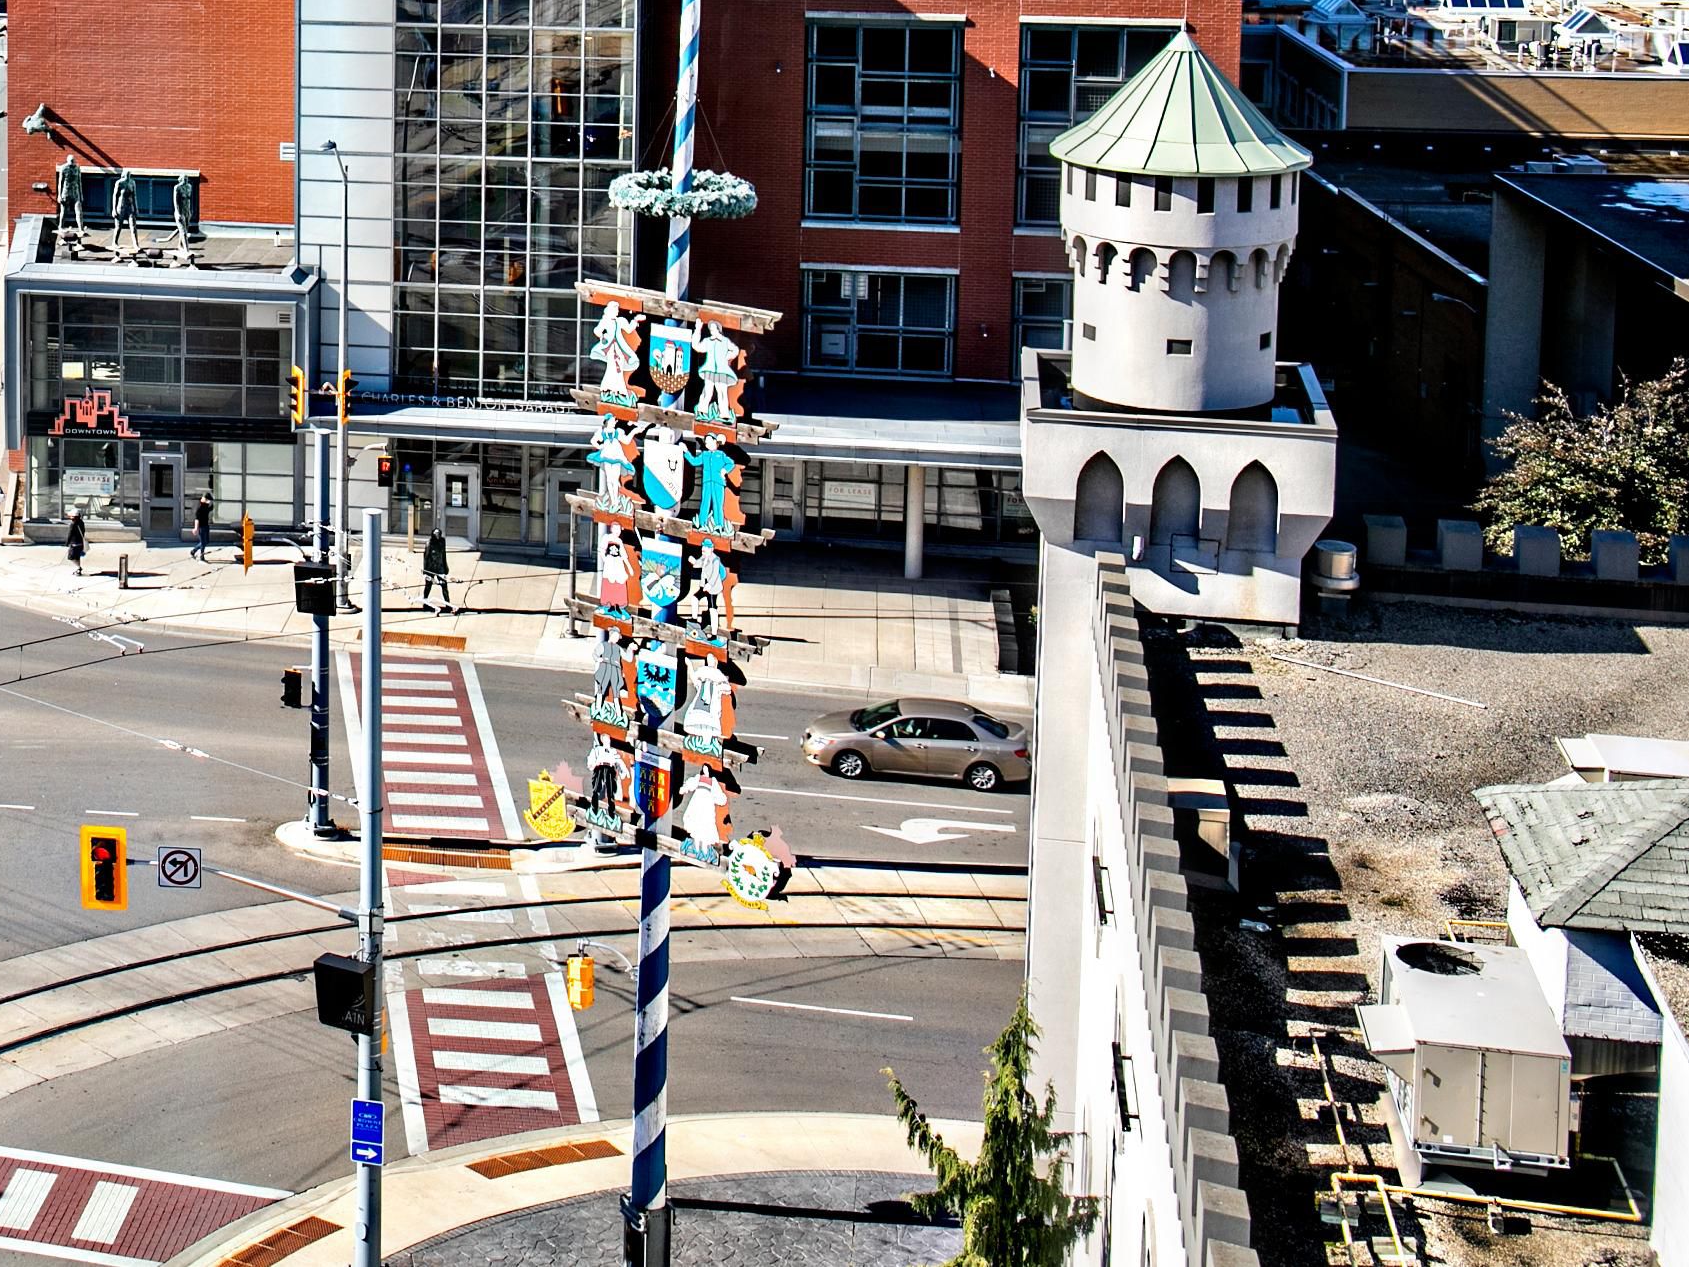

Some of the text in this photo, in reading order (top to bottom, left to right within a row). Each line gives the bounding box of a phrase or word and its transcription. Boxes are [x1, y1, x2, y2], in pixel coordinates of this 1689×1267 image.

[361, 391, 425, 406] CHARLES
[431, 396, 441, 407] &
[446, 396, 507, 411] BENTON
